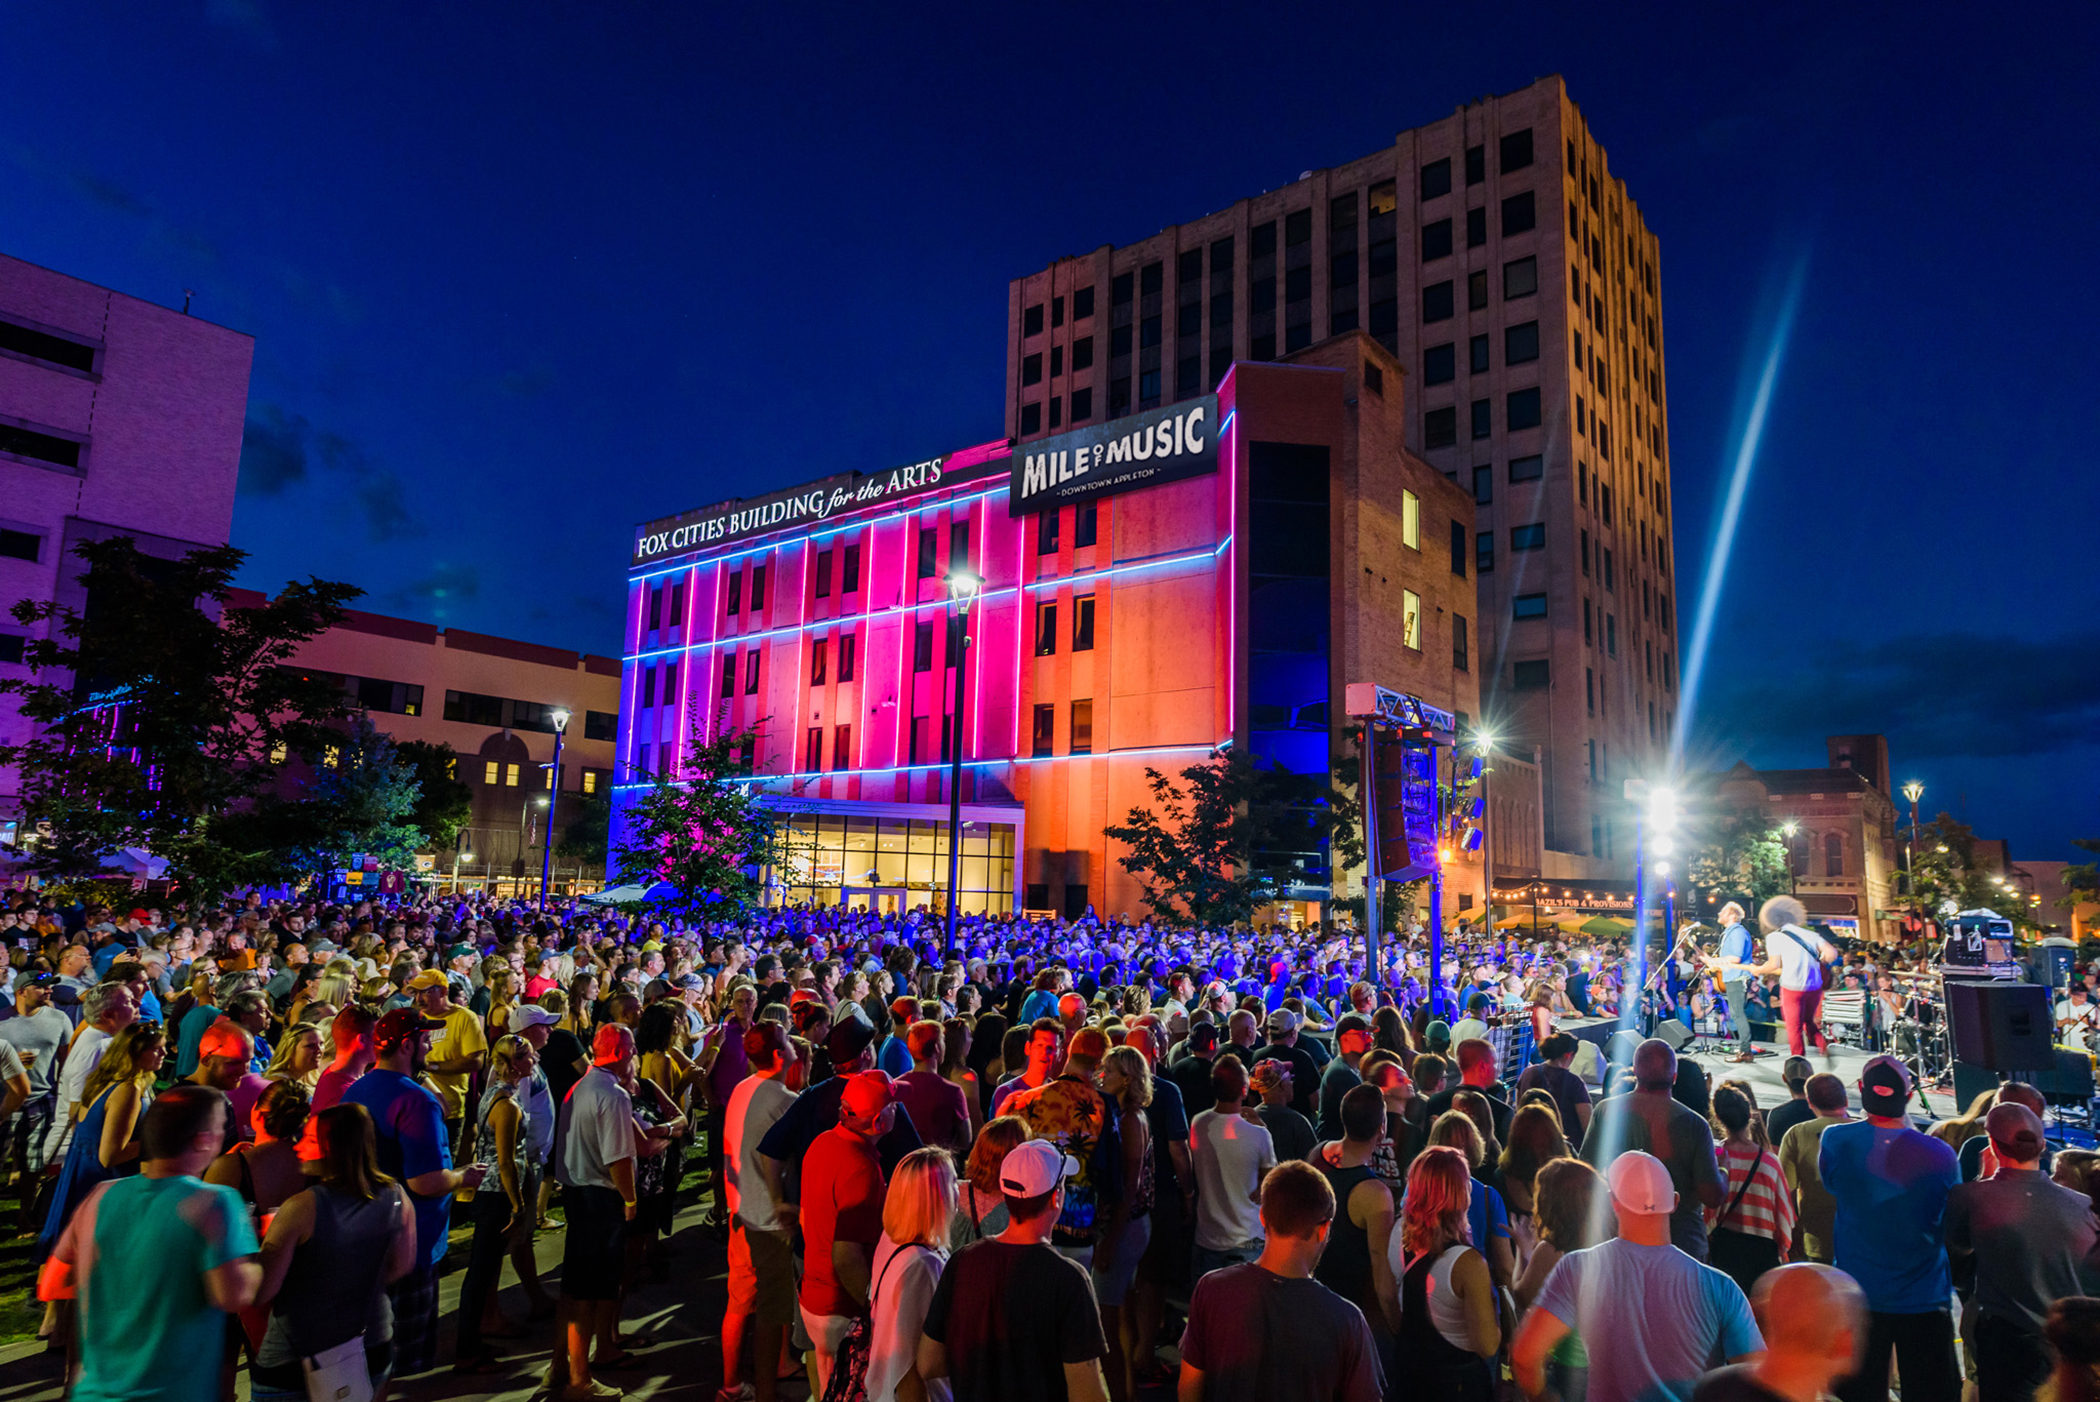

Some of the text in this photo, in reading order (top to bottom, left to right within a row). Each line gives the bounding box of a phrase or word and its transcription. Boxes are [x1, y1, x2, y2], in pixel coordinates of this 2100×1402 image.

[1021, 406, 1204, 499] MILE OF MUSIC
[1113, 467, 1155, 485] APPLETON
[637, 458, 942, 558] FOX CITIES BUILDING for the ARTS
[1564, 898, 1580, 908] PUB
[1581, 900, 1587, 908] &
[1589, 900, 1634, 909] PROVISIONS
